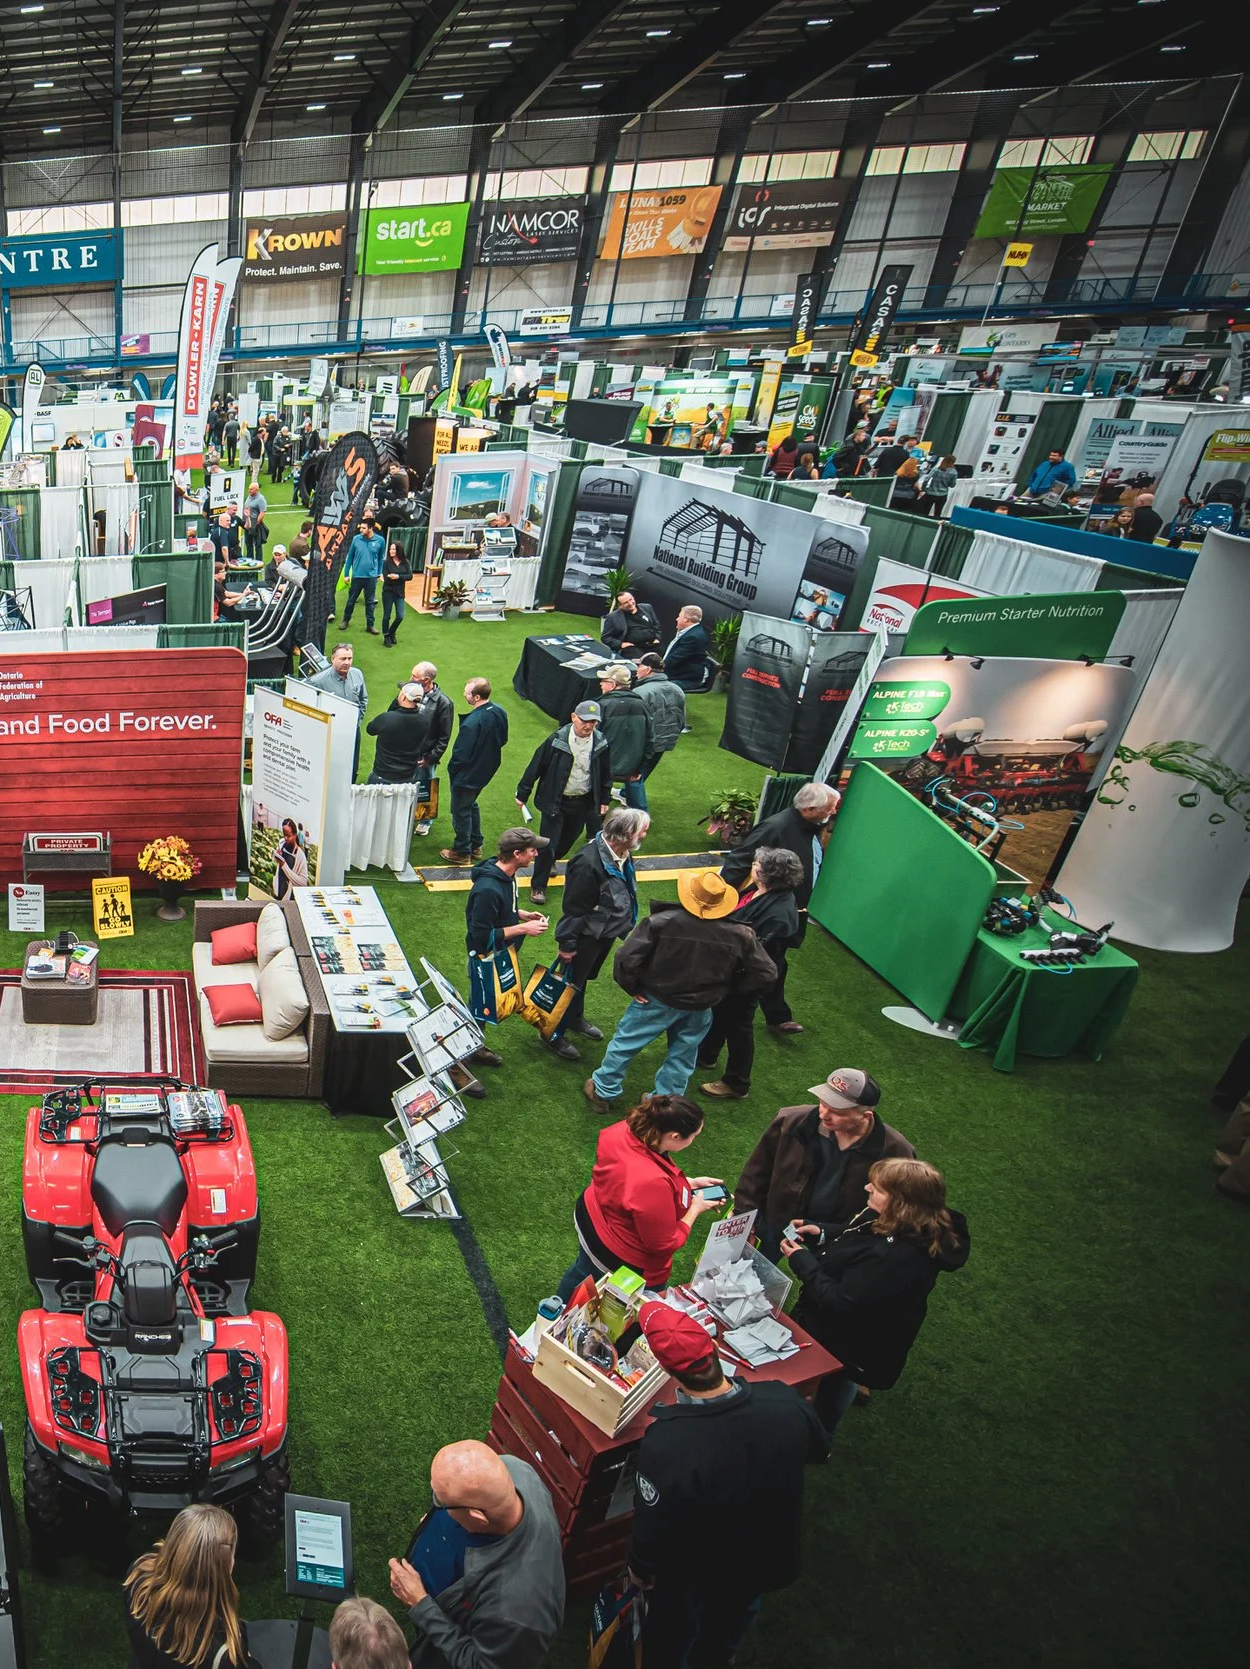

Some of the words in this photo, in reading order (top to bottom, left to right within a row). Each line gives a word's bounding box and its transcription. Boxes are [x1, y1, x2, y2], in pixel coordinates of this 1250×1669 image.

[659, 195, 686, 207] 1059
[376, 218, 453, 241] start.ca
[490, 210, 579, 233] NAMCOR
[247, 227, 343, 262] KROWN
[245, 266, 277, 277] Protect.
[279, 264, 316, 275] Maintain.
[319, 261, 343, 272] Save.
[193, 282, 204, 328] KARN
[187, 341, 200, 410] DOWLER
[1092, 422, 1135, 438] Allied
[460, 444, 469, 452] WE
[1119, 440, 1168, 448] CountryGuide
[653, 545, 688, 570] National
[687, 558, 726, 588] Building
[726, 573, 758, 601] Group
[870, 609, 903, 628] National
[937, 608, 997, 624] Premium
[999, 605, 1046, 621] Starter
[1049, 602, 1104, 619] Nutrition
[36, 680, 43, 689] of
[0, 692, 36, 702] Agriculture
[873, 691, 906, 699] ALPINE
[49, 713, 110, 734] Food
[119, 711, 217, 732] Forever.
[264, 712, 282, 726] OFA
[864, 729, 897, 737] ALPINE
[263, 733, 279, 745] Protect
[280, 741, 290, 749] your
[290, 745, 301, 754] farm
[263, 747, 295, 765] comprehensive
[296, 760, 310, 772] health
[272, 745, 282, 753] your
[283, 748, 296, 759] family
[297, 755, 307, 763] with
[272, 757, 285, 767] dental
[96, 885, 128, 895] CAUTION
[100, 920, 130, 931] SLOWLY
[720, 1216, 749, 1230] ENTER
